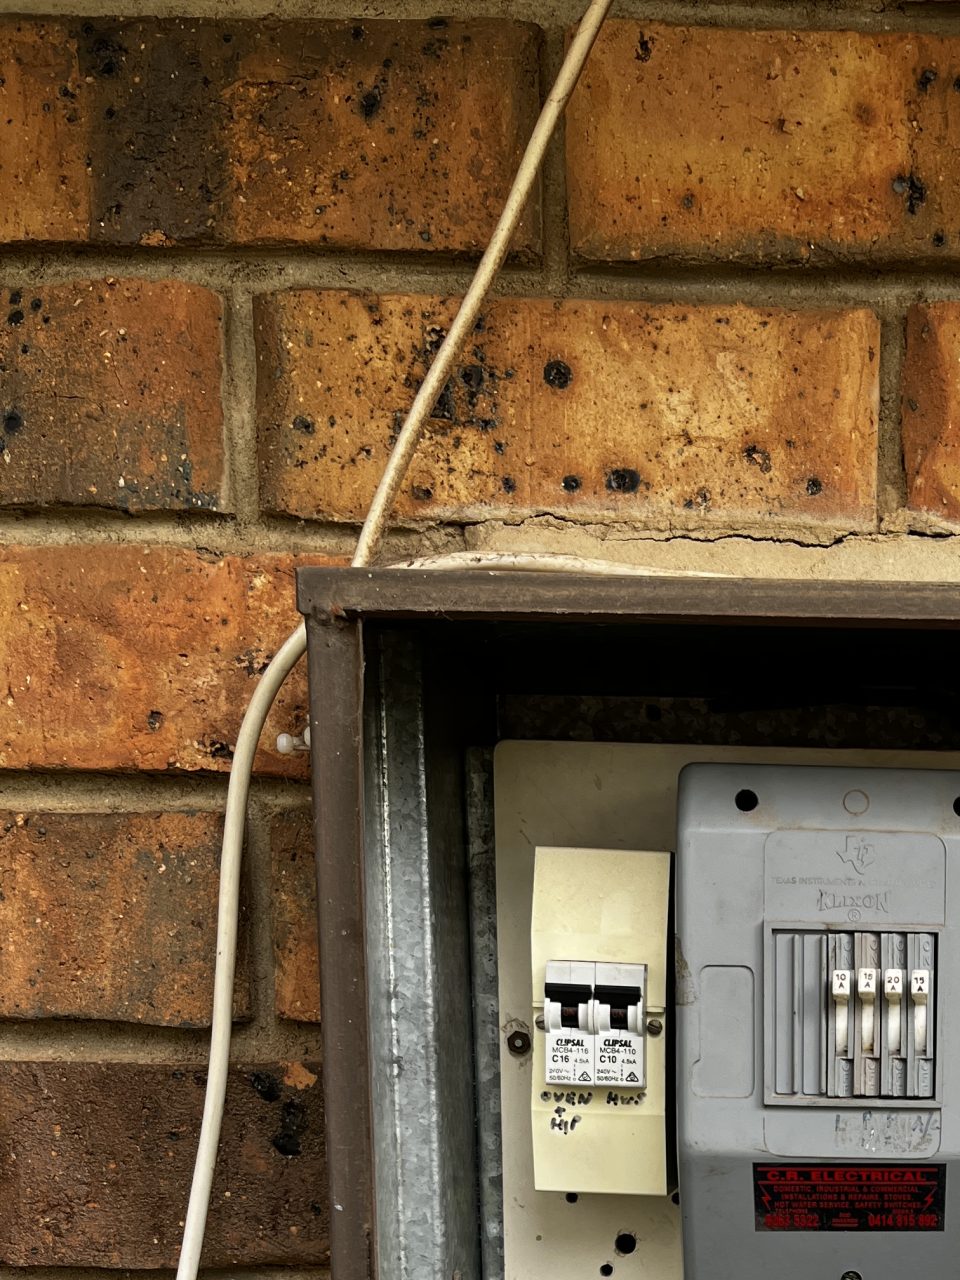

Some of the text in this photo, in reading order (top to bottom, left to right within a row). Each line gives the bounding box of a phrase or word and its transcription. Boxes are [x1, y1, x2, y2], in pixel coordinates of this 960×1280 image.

[835, 973, 847, 981] 10
[863, 972, 873, 980] 15
[887, 976, 900, 984] 20
[914, 976, 925, 985] 15
[556, 1038, 585, 1047] CLIPSAL
[603, 1039, 632, 1048] CLIPSAL
[600, 1047, 636, 1055] MCB4-110
[811, 1170, 927, 1182] ELECTRICAL
